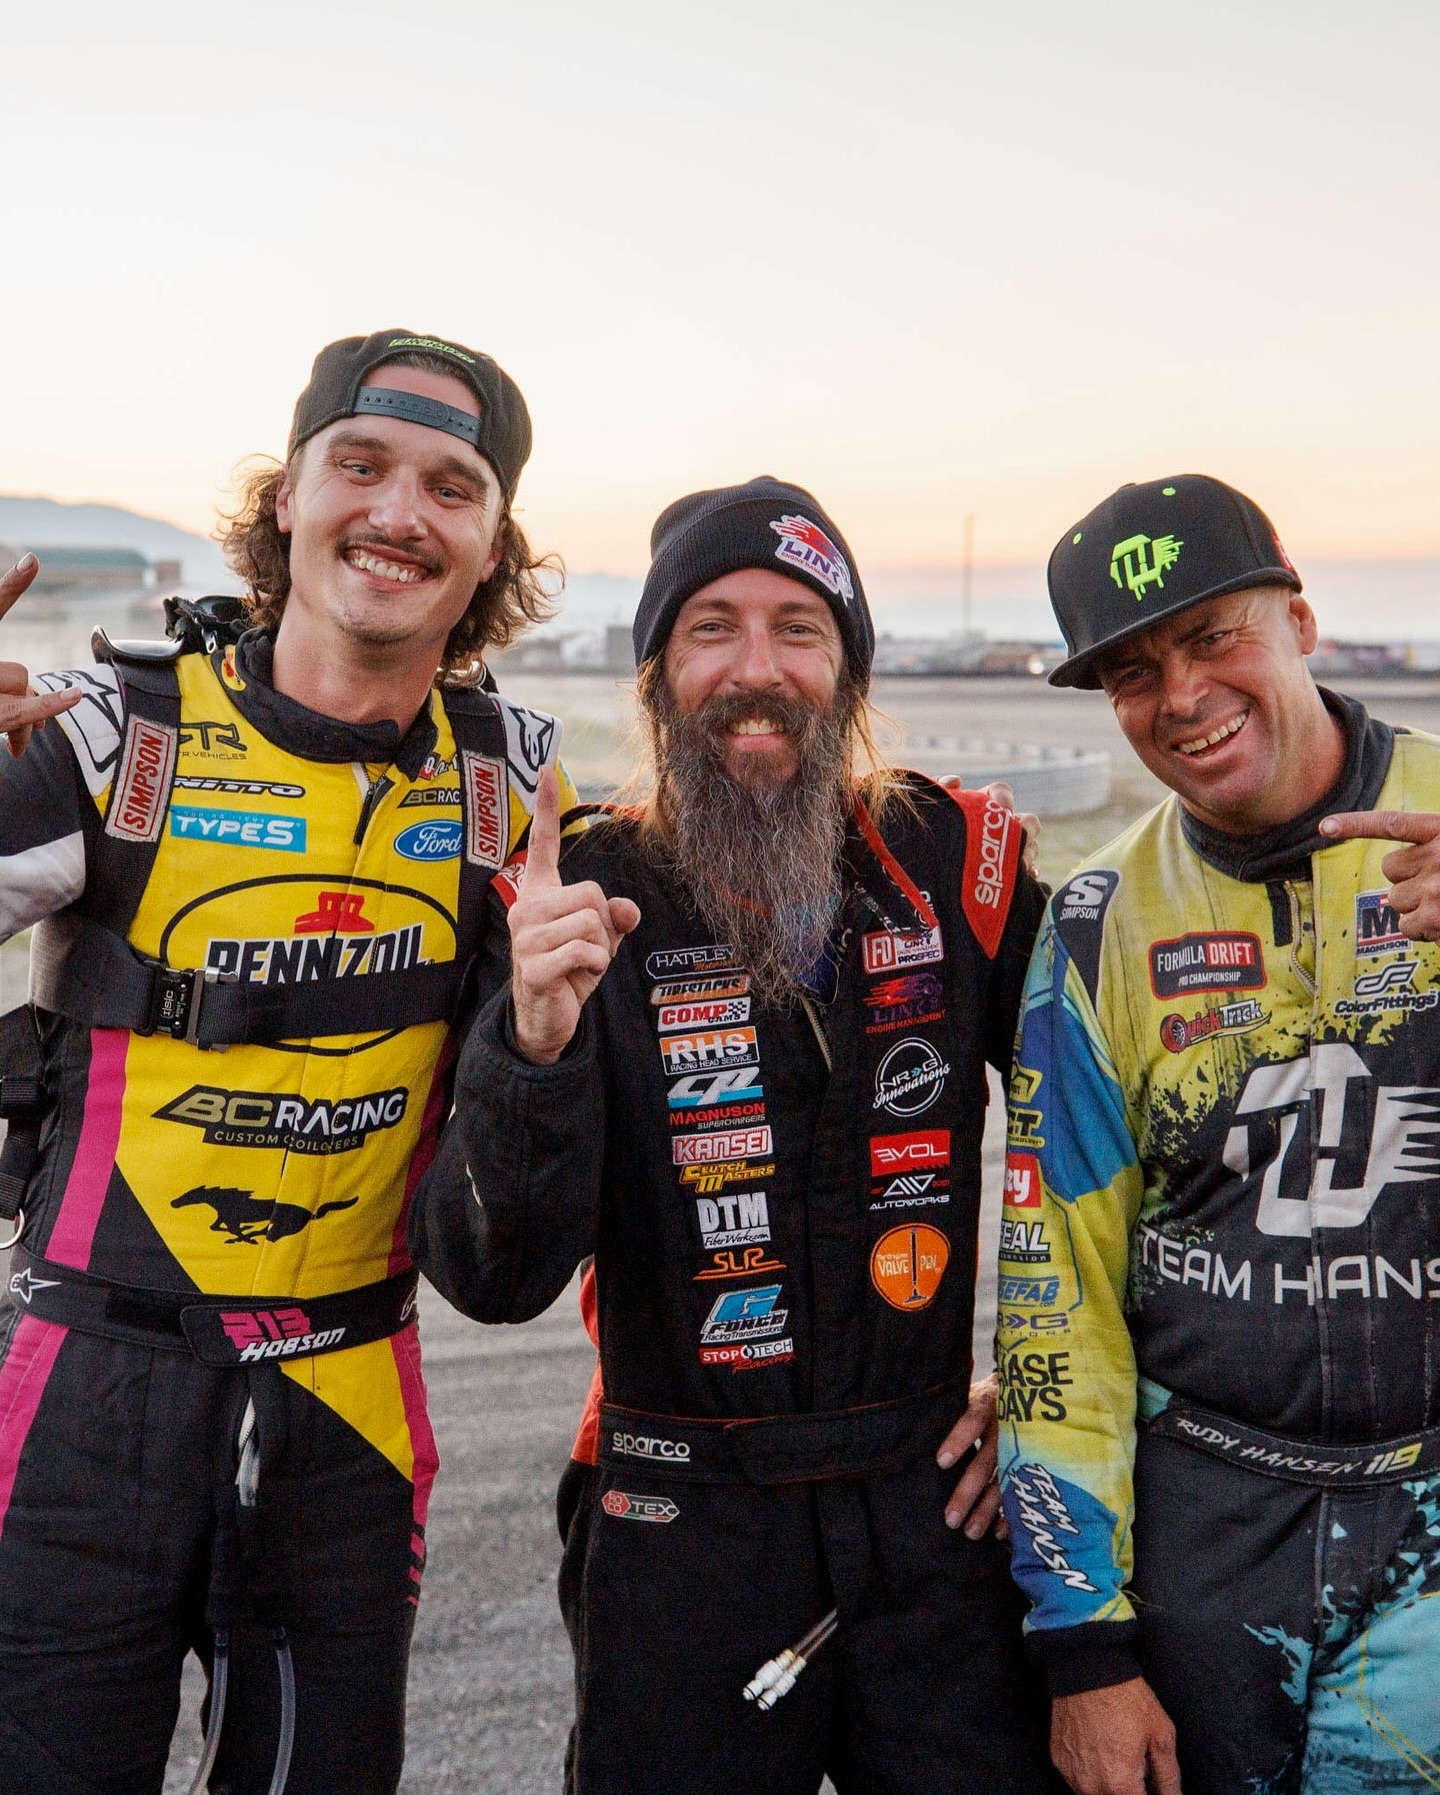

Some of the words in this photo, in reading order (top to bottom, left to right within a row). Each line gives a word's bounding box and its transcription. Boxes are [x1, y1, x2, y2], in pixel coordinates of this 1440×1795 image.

[192, 751, 247, 760] VEHICLES
[123, 731, 165, 830] SIMPSON
[174, 775, 306, 798] NITTO
[478, 765, 498, 858] SIMPSON
[413, 826, 463, 853] Ford
[974, 800, 1006, 906] sparco
[1060, 906, 1100, 921] SIMPSON
[656, 948, 737, 968] HATELEY
[1157, 944, 1206, 973] FORMULA
[1208, 942, 1252, 965] DRIFT
[1357, 940, 1409, 955] MAGNUSON
[1189, 971, 1241, 986] CHAMPIONSHIP
[662, 1003, 728, 1025] COMP
[708, 1014, 741, 1024] CAMS
[866, 1021, 896, 1034] ENGINE
[897, 1009, 947, 1028] MANAGEMENT
[669, 1033, 749, 1064] RHS
[670, 1062, 698, 1073] RACING
[700, 1058, 720, 1068] HEAD
[722, 1053, 752, 1065] SERVICE
[669, 1102, 766, 1126] MAGNUSON
[698, 1114, 766, 1130] SUPERCHARGERS
[214, 1130, 279, 1145] CUSTOM
[674, 1129, 769, 1163] KANSEI
[679, 1161, 747, 1184] CLUTCH
[696, 1163, 776, 1193] MASTERS
[696, 1192, 769, 1233] DTM
[869, 1195, 950, 1210] AUTOWORKS
[1000, 1222, 1050, 1252] EAL
[877, 1258, 909, 1278] VALVE
[1140, 1225, 1251, 1301] TEAM
[220, 1308, 312, 1349] 213
[708, 1313, 786, 1335] FORCE
[612, 1431, 691, 1460] sparco
[1176, 1417, 1240, 1450] RUDY
[1240, 1446, 1363, 1475] HANSEN
[1022, 1463, 1080, 1534] TEAM
[1007, 1469, 1102, 1593] HANSN
